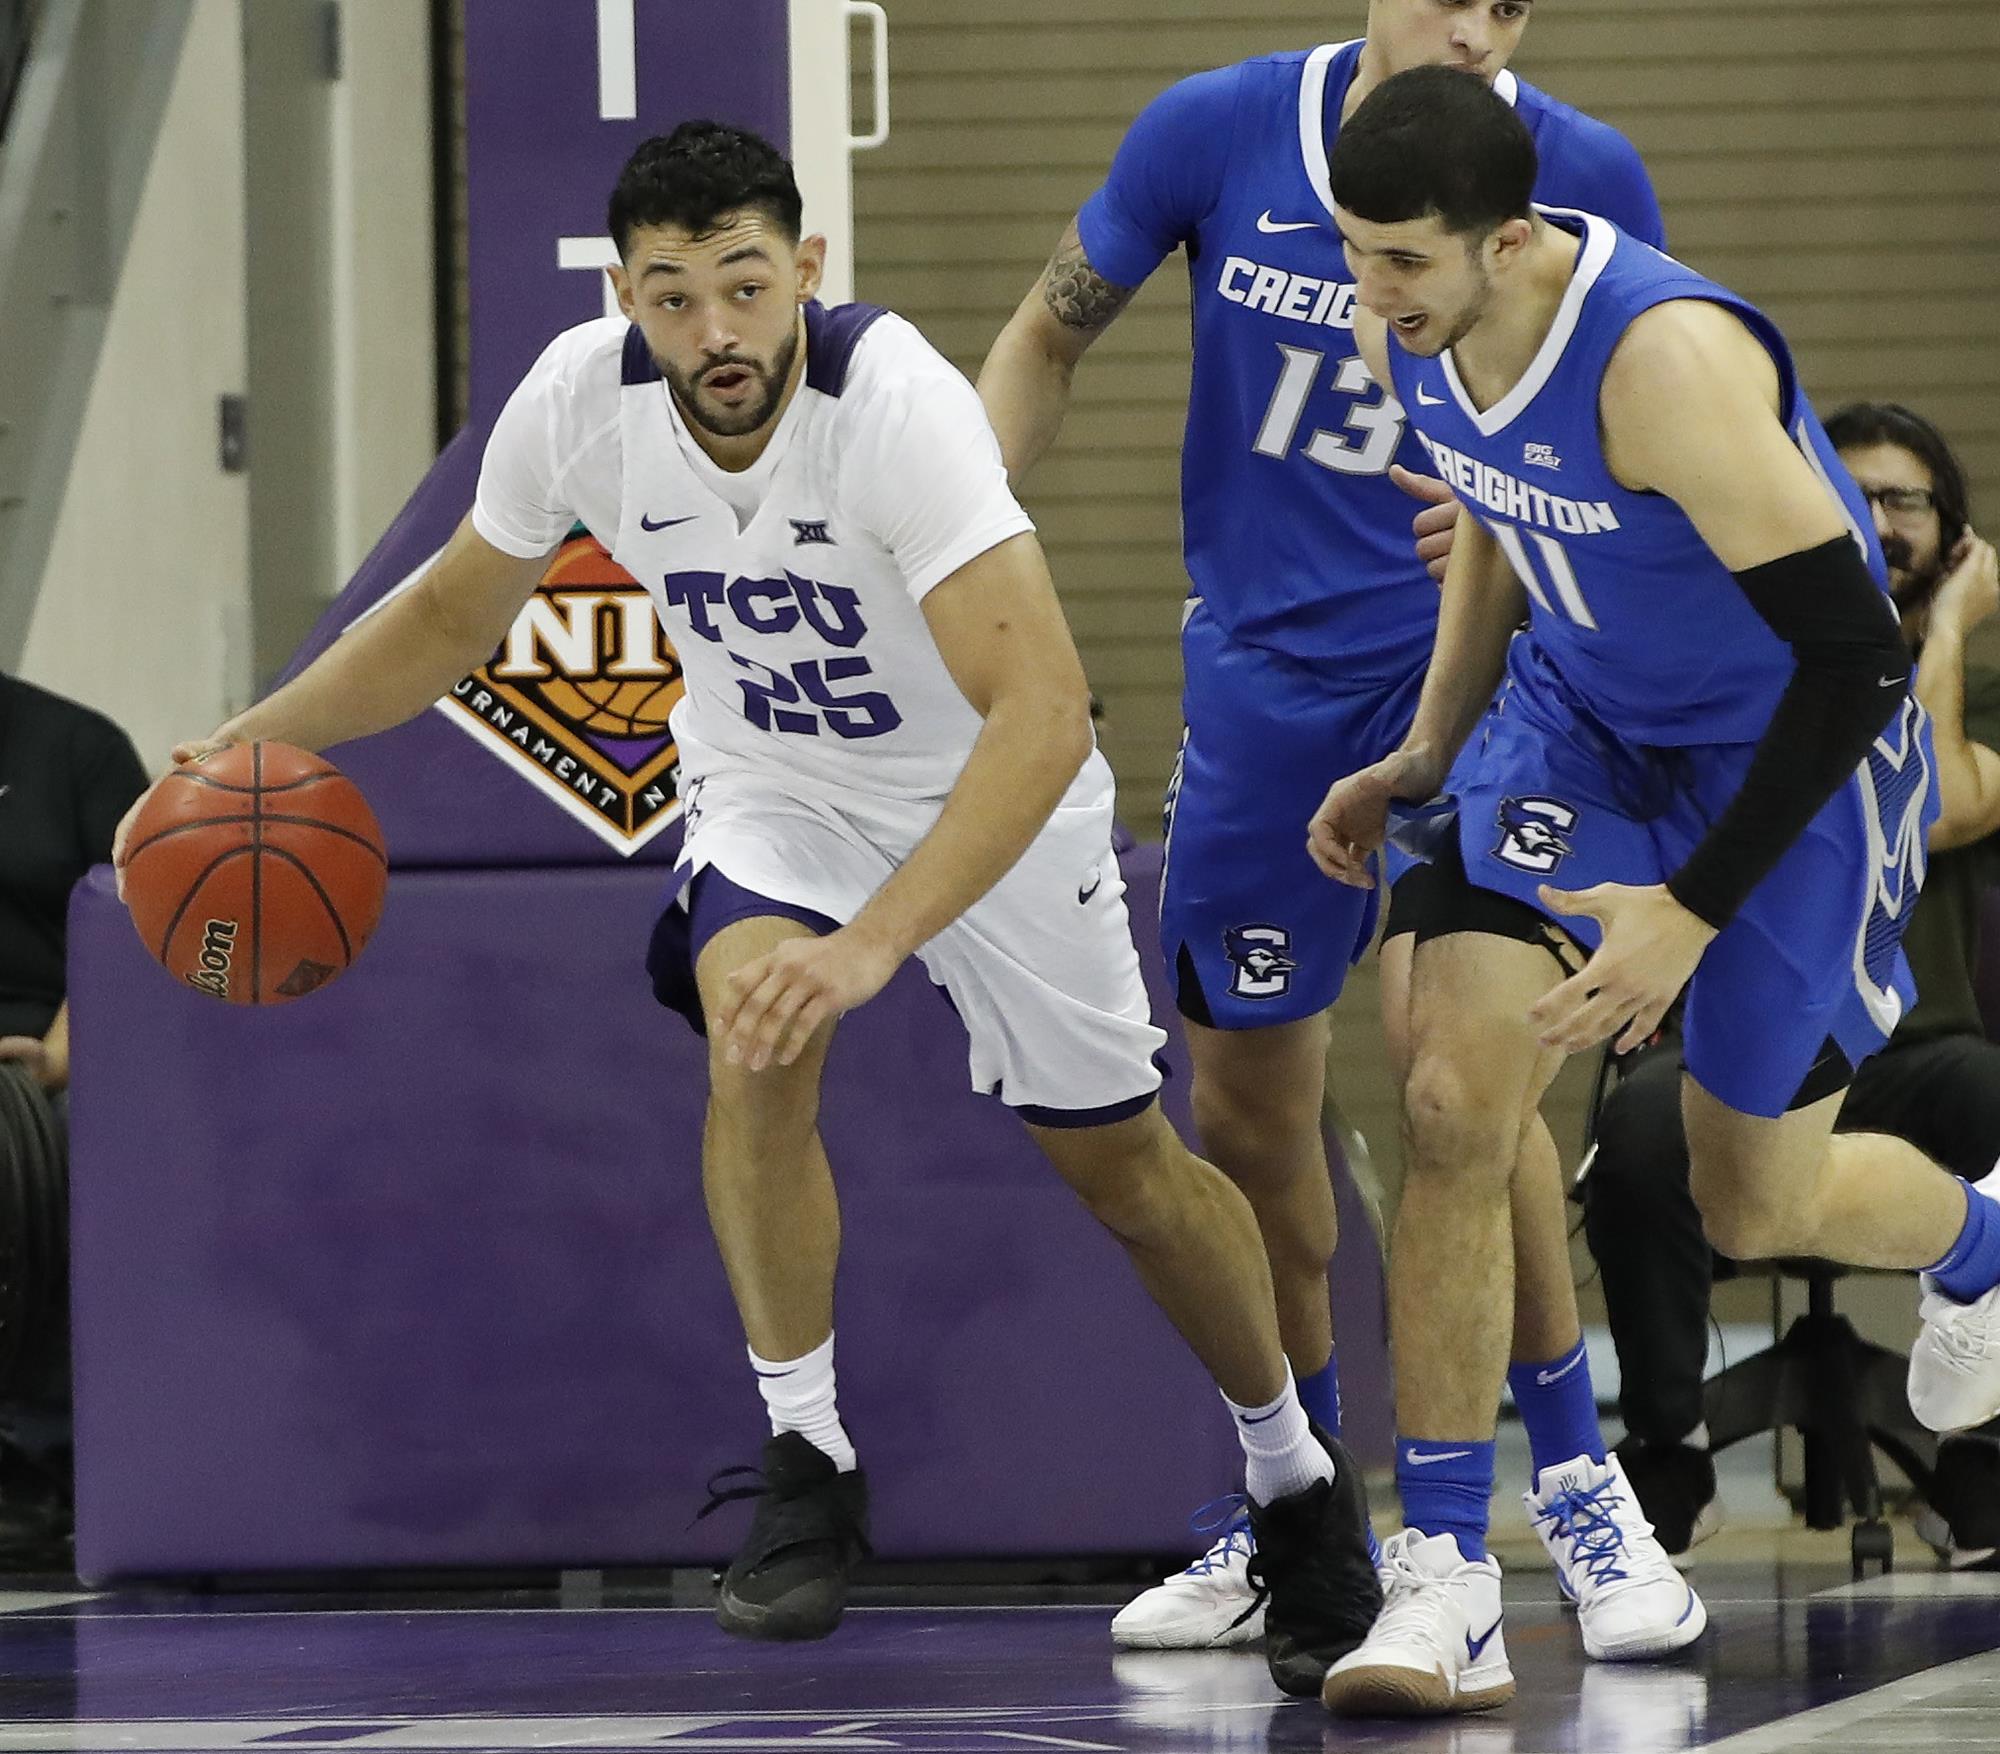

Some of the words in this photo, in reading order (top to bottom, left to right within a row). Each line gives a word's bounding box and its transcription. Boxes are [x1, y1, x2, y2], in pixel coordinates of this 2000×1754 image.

[1217, 256, 1358, 330] CREIG
[1251, 342, 1407, 476] 13
[1415, 429, 1621, 534] REIGHTON
[1524, 452, 1562, 467] EAST
[664, 568, 868, 649] TCU
[1482, 515, 1600, 631] 11
[727, 650, 904, 740] 25
